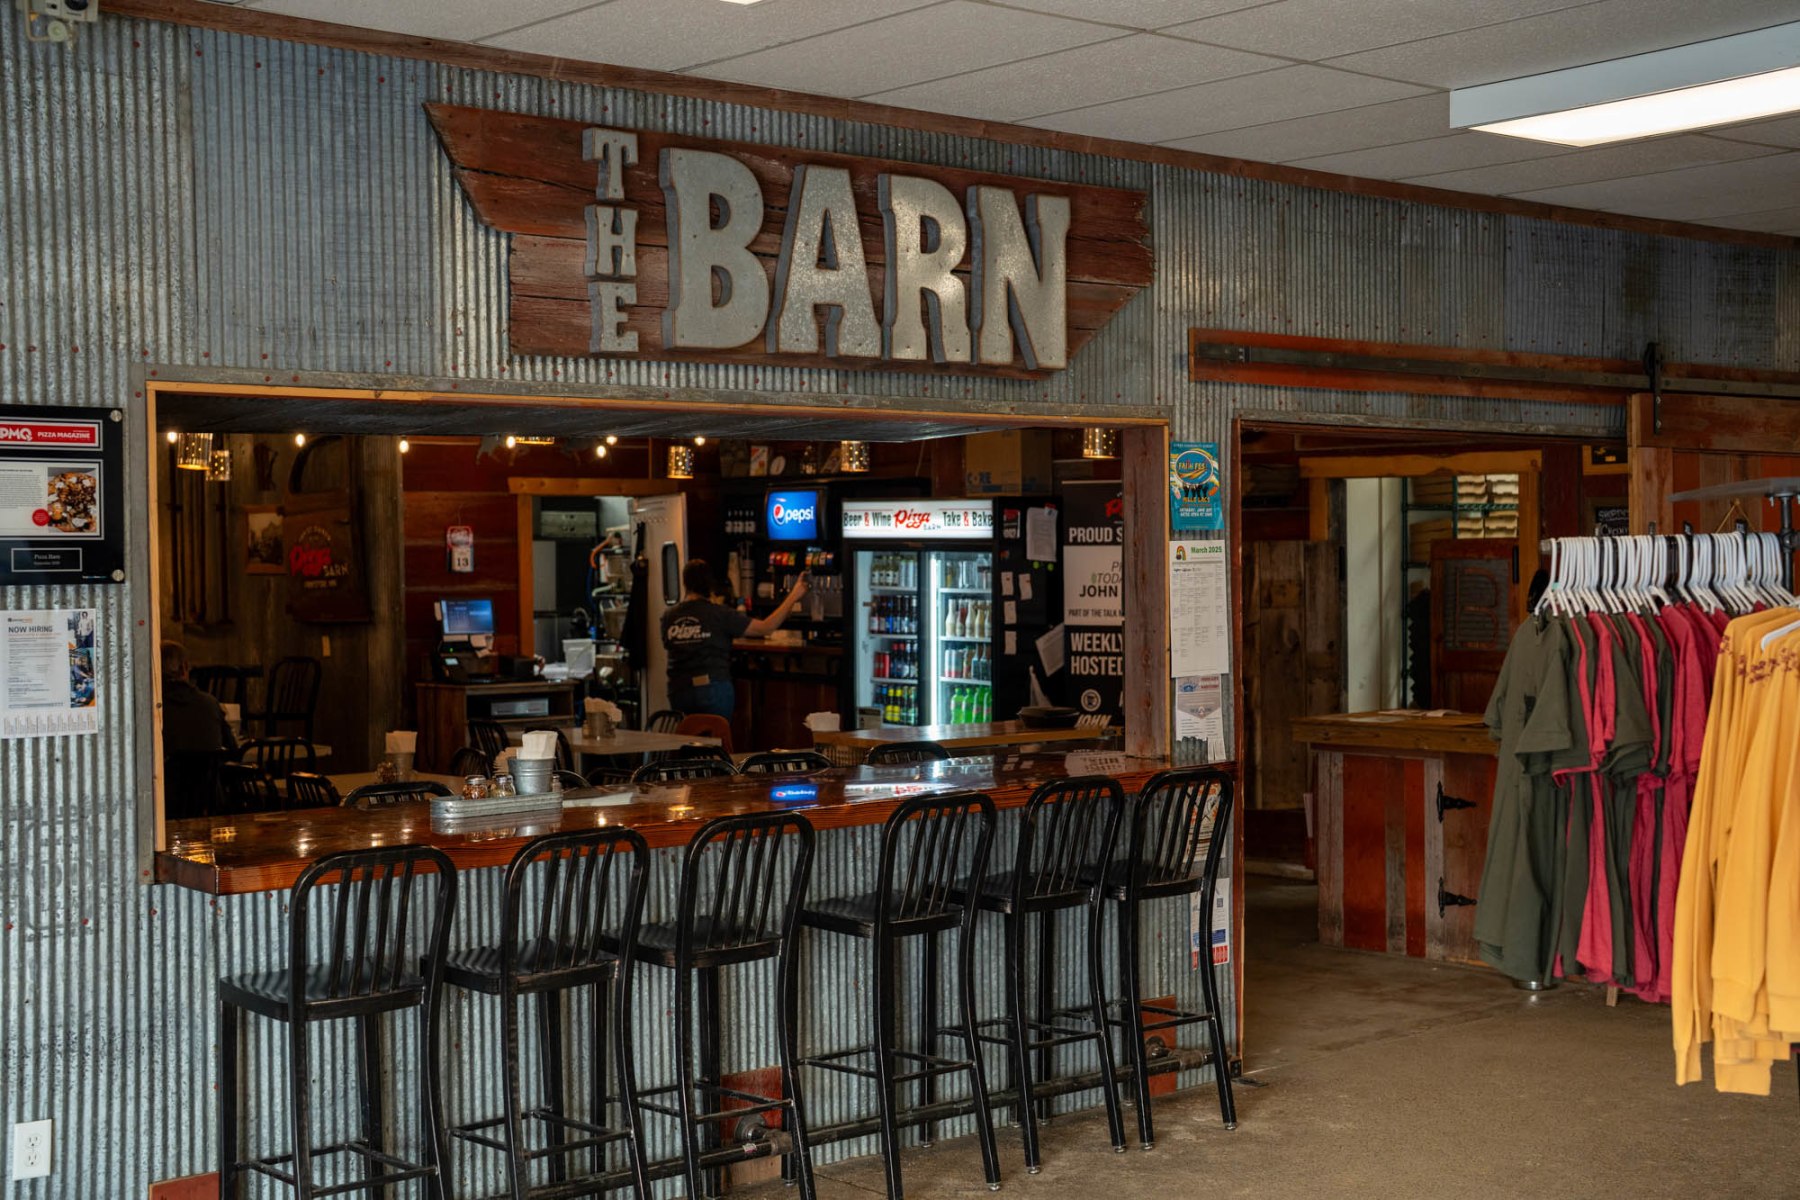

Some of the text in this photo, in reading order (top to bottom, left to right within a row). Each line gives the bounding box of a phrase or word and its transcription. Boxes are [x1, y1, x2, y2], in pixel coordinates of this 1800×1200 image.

[582, 126, 1072, 371] THE BARN
[785, 505, 814, 524] pepsi
[843, 511, 891, 527] Beer & Wine
[893, 508, 931, 529] Pizza
[942, 511, 961, 527] Take
[963, 511, 969, 527] &
[972, 511, 994, 527] Bake
[1068, 526, 1114, 543] PROUD
[1208, 545, 1222, 553] 2025
[1097, 573, 1122, 584] TOD
[1079, 585, 1118, 597] JOHN
[1068, 608, 1082, 617] PART
[1082, 608, 1090, 617] OF
[1091, 608, 1103, 617] THE
[1103, 608, 1117, 617] TALK
[28, 625, 53, 633] HIRING
[1073, 713, 1112, 730] JOHN
